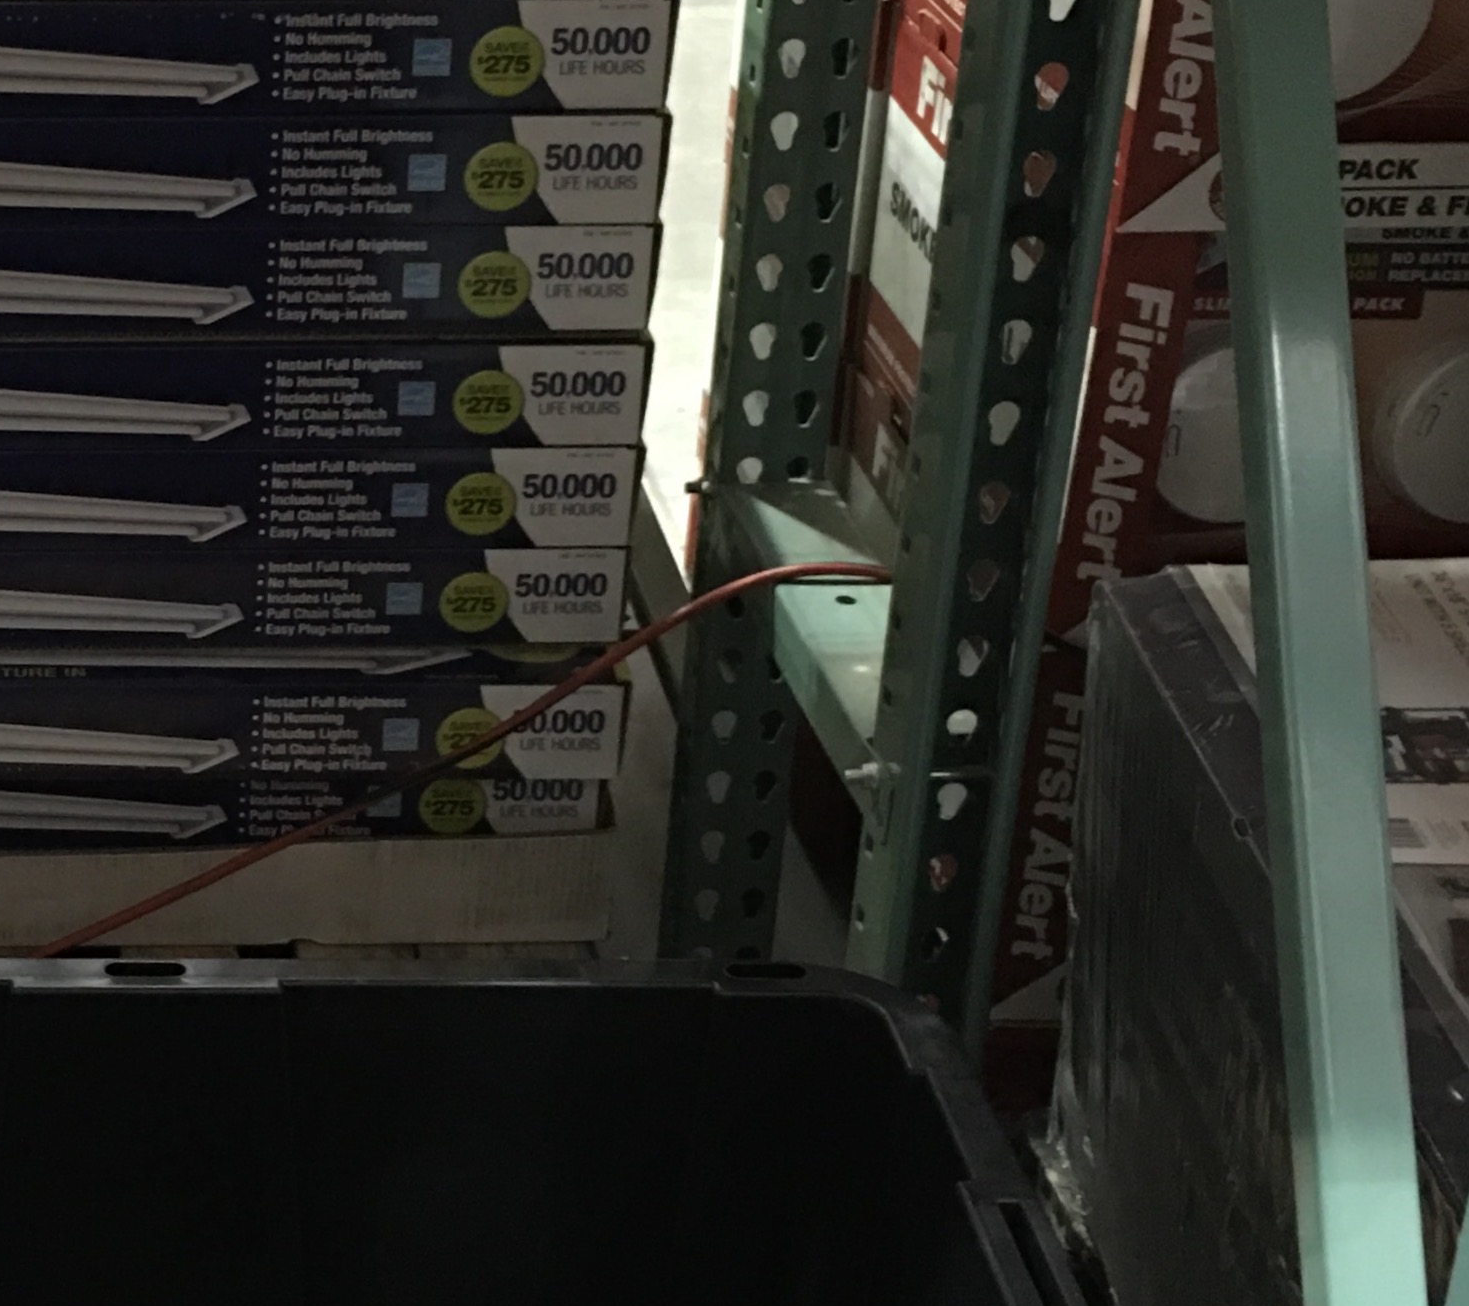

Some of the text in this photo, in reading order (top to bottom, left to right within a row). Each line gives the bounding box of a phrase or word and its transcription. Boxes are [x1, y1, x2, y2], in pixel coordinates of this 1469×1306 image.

[559, 59, 645, 75] LIFE HOURS
[1338, 158, 1419, 180] PACK
[553, 175, 638, 191] LIFE HOURS
[545, 282, 629, 298] LIFE HOURS
[1353, 298, 1405, 311] PACK
[1077, 282, 1174, 582] First Alert
[1011, 827, 1073, 960] Alert
